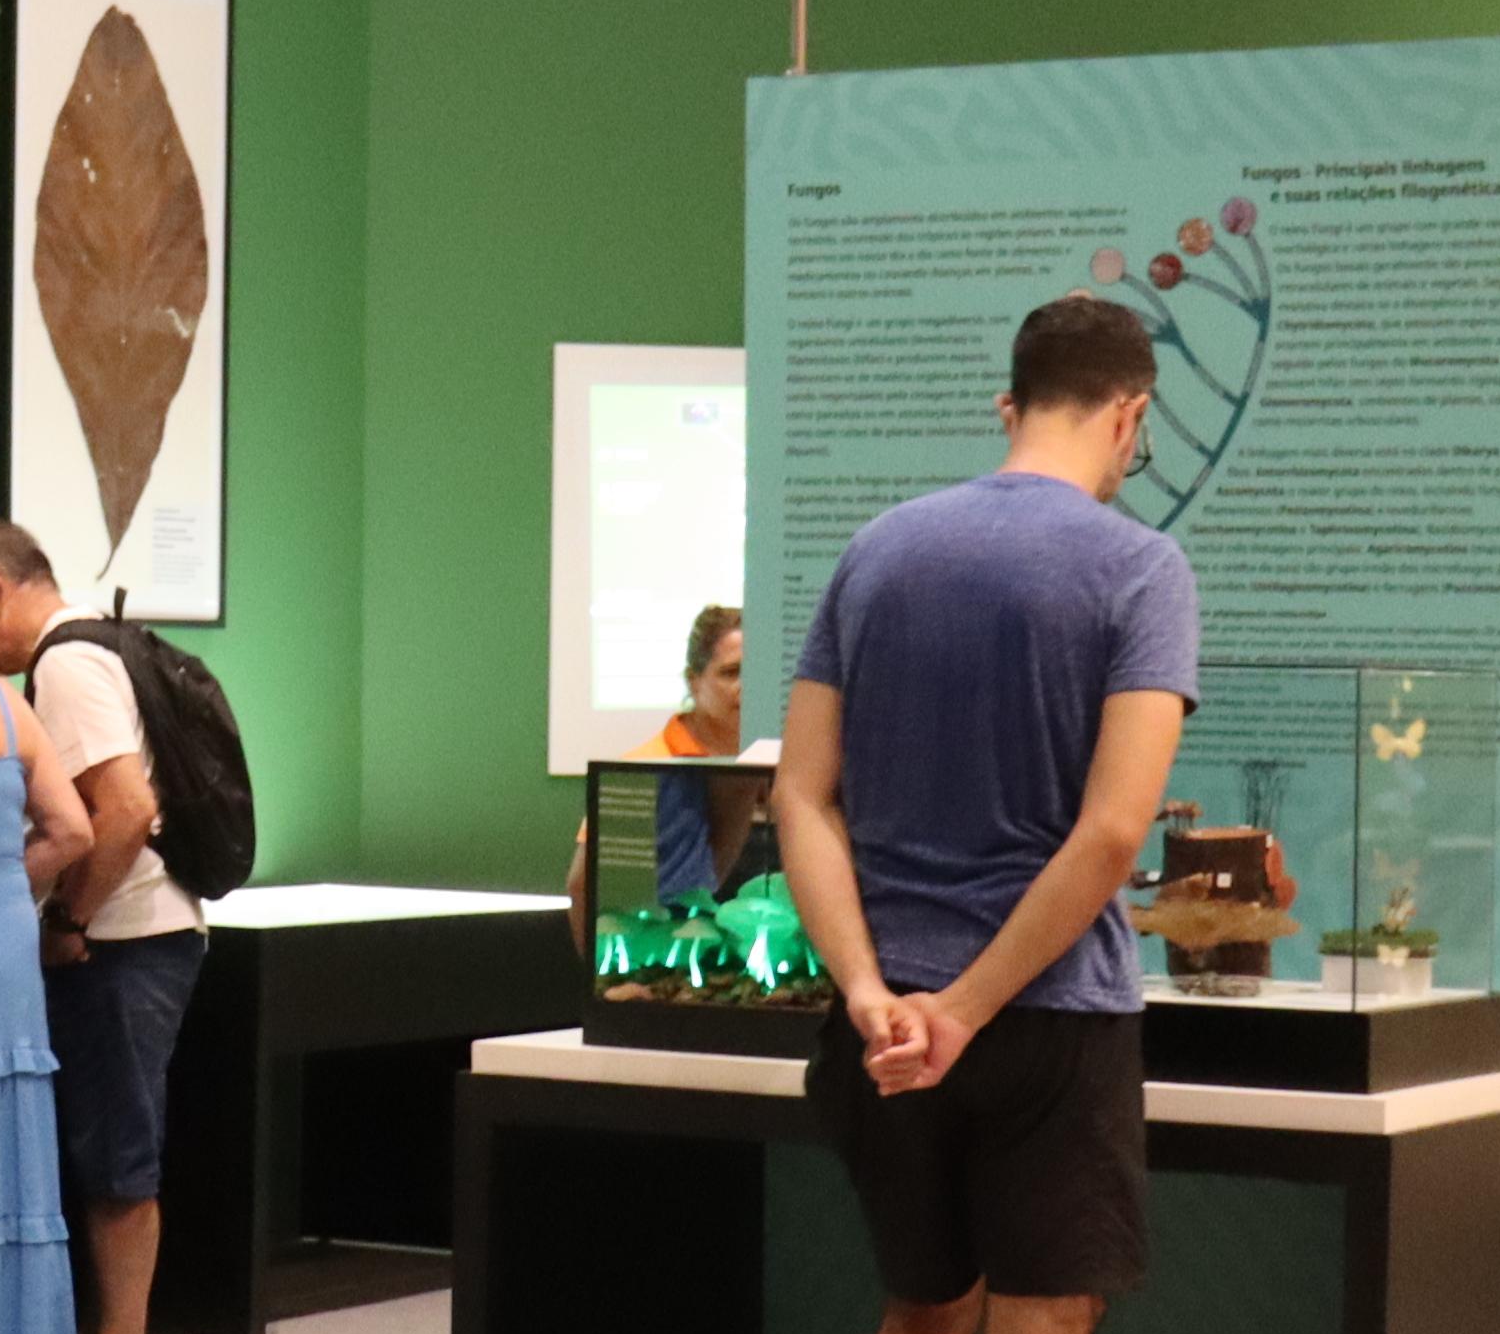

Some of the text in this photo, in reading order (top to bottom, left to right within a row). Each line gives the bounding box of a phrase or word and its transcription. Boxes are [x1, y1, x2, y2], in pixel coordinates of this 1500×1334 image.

[1242, 166, 1301, 183] Fungos
[1315, 162, 1397, 180] Principais
[1402, 159, 1486, 177] linhagens
[788, 183, 841, 199] Fungos
[1269, 192, 1280, 201] e
[1283, 190, 1321, 201] suas
[1325, 185, 1395, 203] relações
